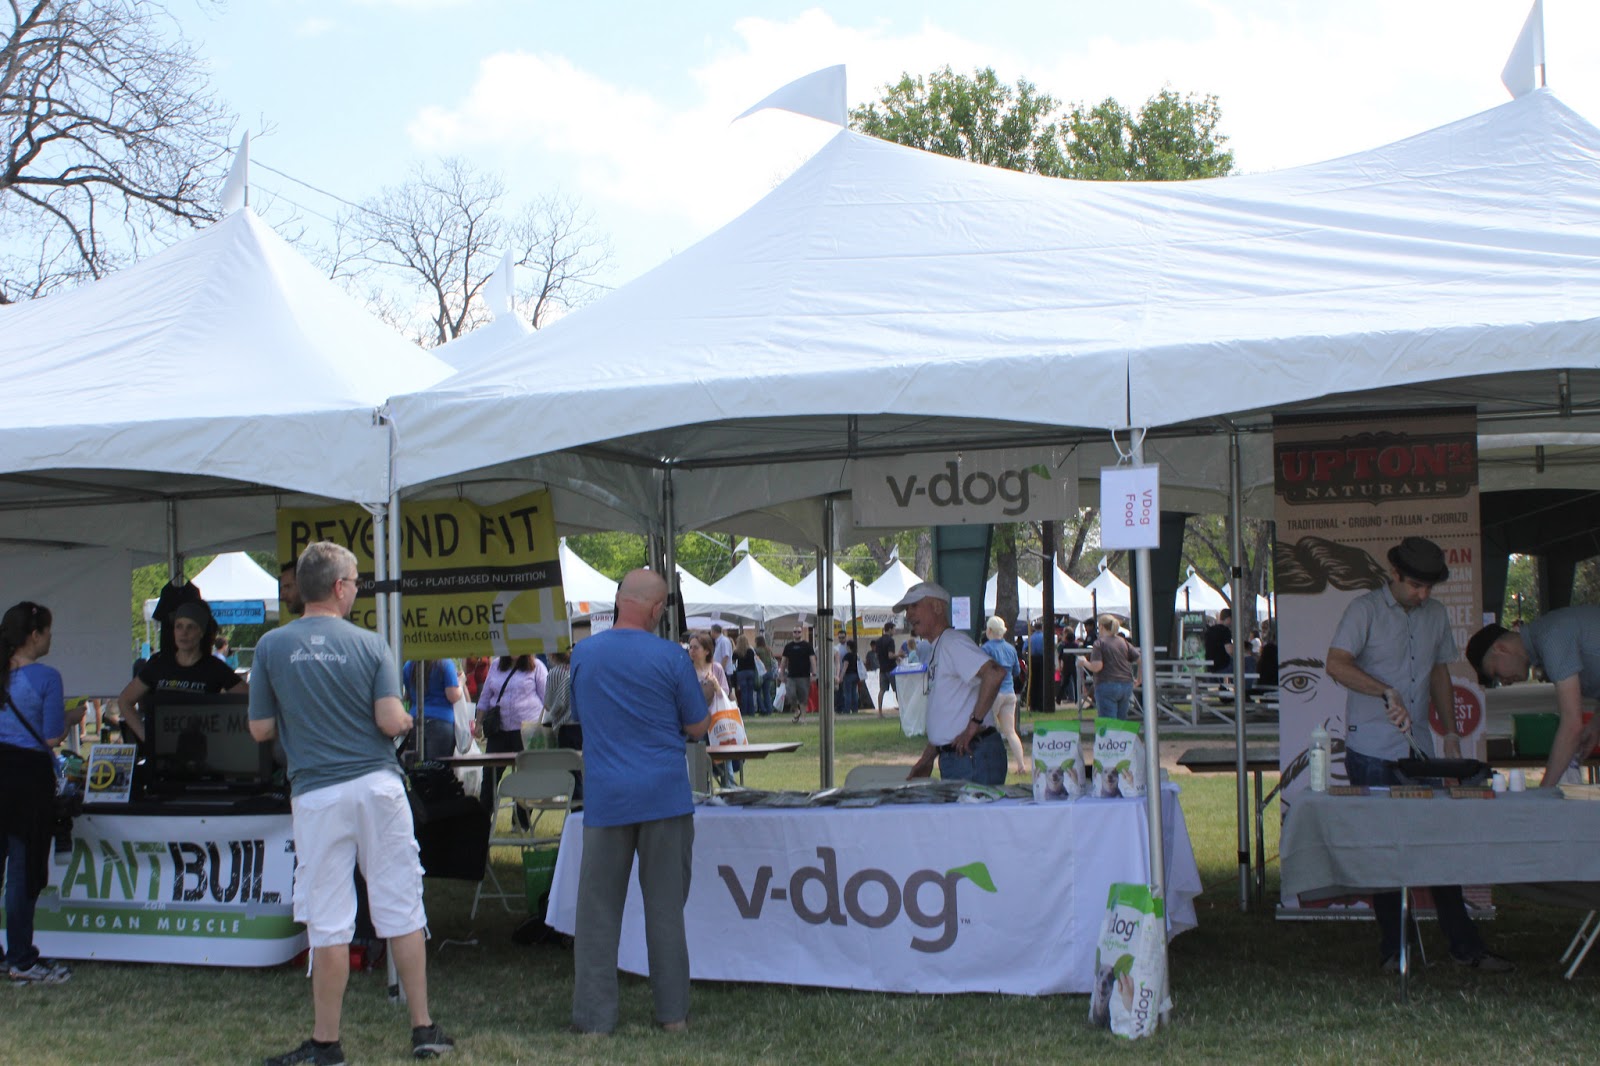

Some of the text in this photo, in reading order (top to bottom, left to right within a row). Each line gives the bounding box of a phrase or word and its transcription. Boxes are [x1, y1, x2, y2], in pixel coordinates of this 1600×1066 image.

[885, 461, 1031, 516] v-dog
[1305, 480, 1448, 499] NATURALS
[1125, 493, 1136, 527] Food
[1139, 489, 1153, 526] VDog
[479, 506, 539, 555] FIT
[1287, 511, 1469, 531] TRADITIONAL GROUND ITALIAN CHORIZO
[425, 573, 490, 588] PLANT-BASED
[492, 570, 547, 584] NUTRITION
[438, 603, 506, 626] MORE
[1184, 614, 1203, 623] ATM
[190, 681, 206, 690] FIT
[717, 846, 959, 953] v-dog
[66, 914, 240, 933] VEGAN MUSCLE
